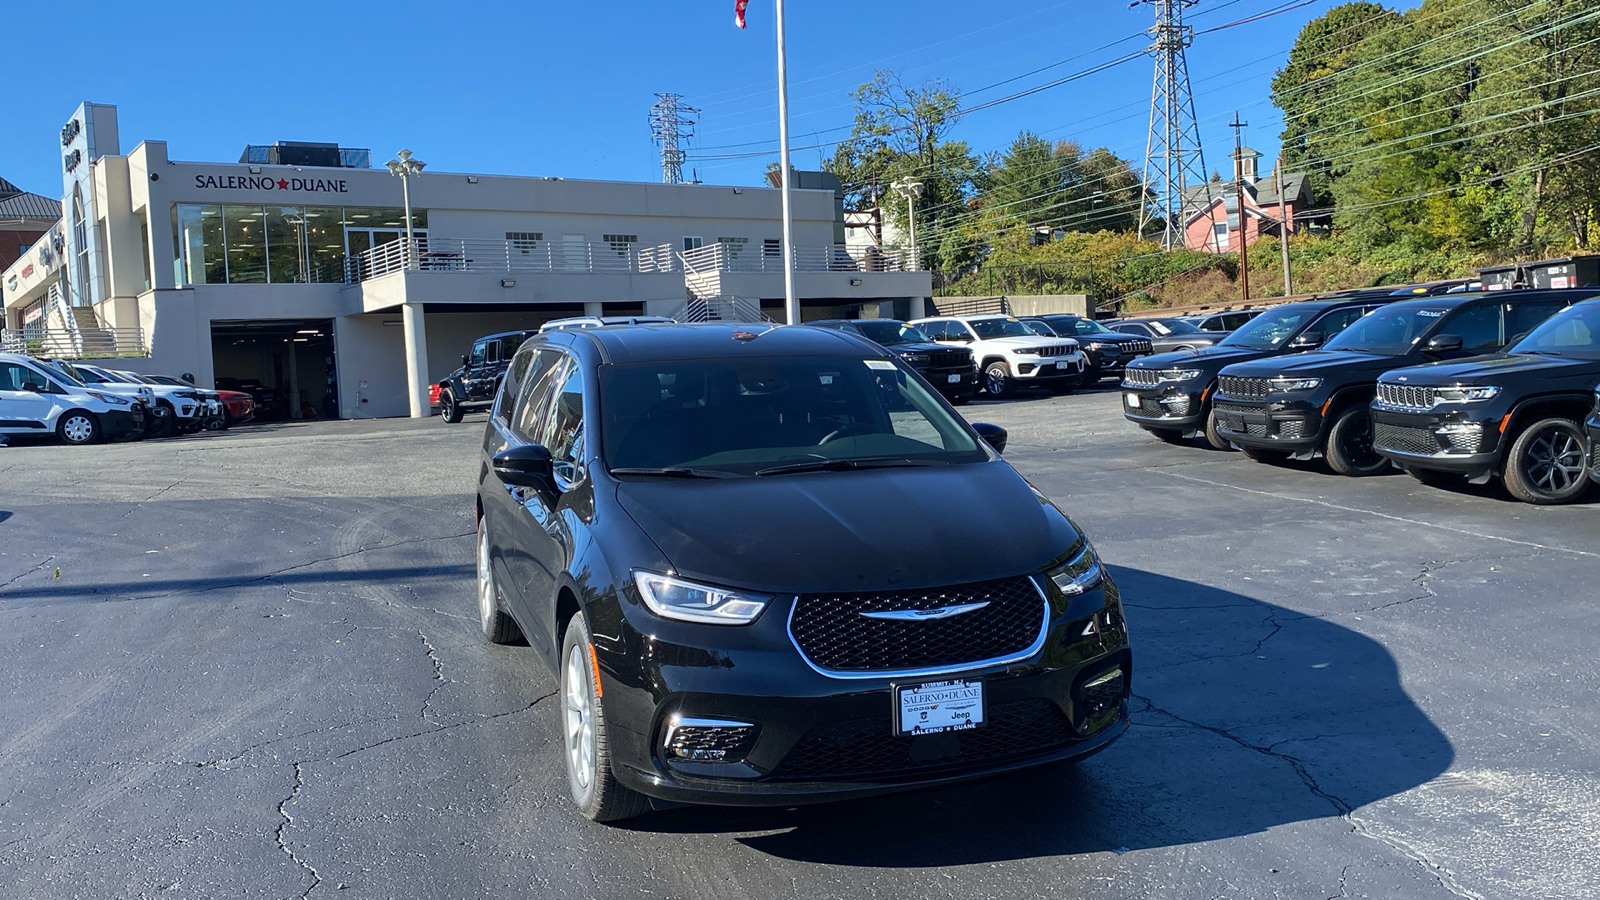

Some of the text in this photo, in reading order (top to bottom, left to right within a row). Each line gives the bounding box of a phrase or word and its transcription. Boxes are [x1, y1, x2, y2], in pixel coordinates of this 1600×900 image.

[195, 175, 348, 193] SALERNO DUANE
[903, 693, 944, 705] SALERNO
[949, 688, 979, 699] DUANE
[911, 727, 943, 735] SALERNO
